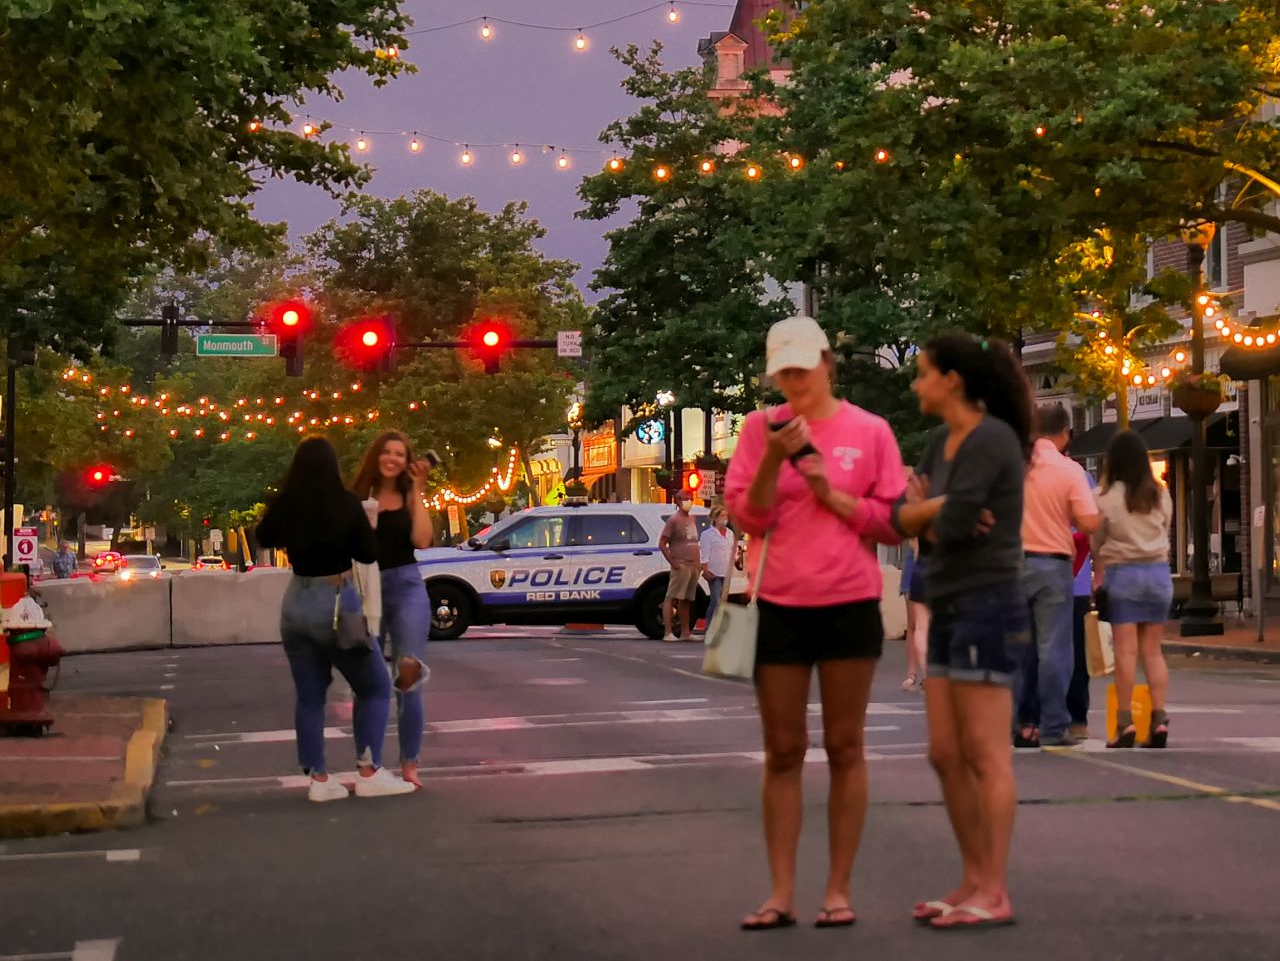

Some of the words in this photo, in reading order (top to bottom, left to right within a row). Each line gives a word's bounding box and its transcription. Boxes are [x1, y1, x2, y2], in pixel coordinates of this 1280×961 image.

[203, 340, 254, 351] Monmouth
[508, 566, 626, 587] POLICE
[526, 591, 555, 601] RED
[559, 590, 600, 600] BANK
